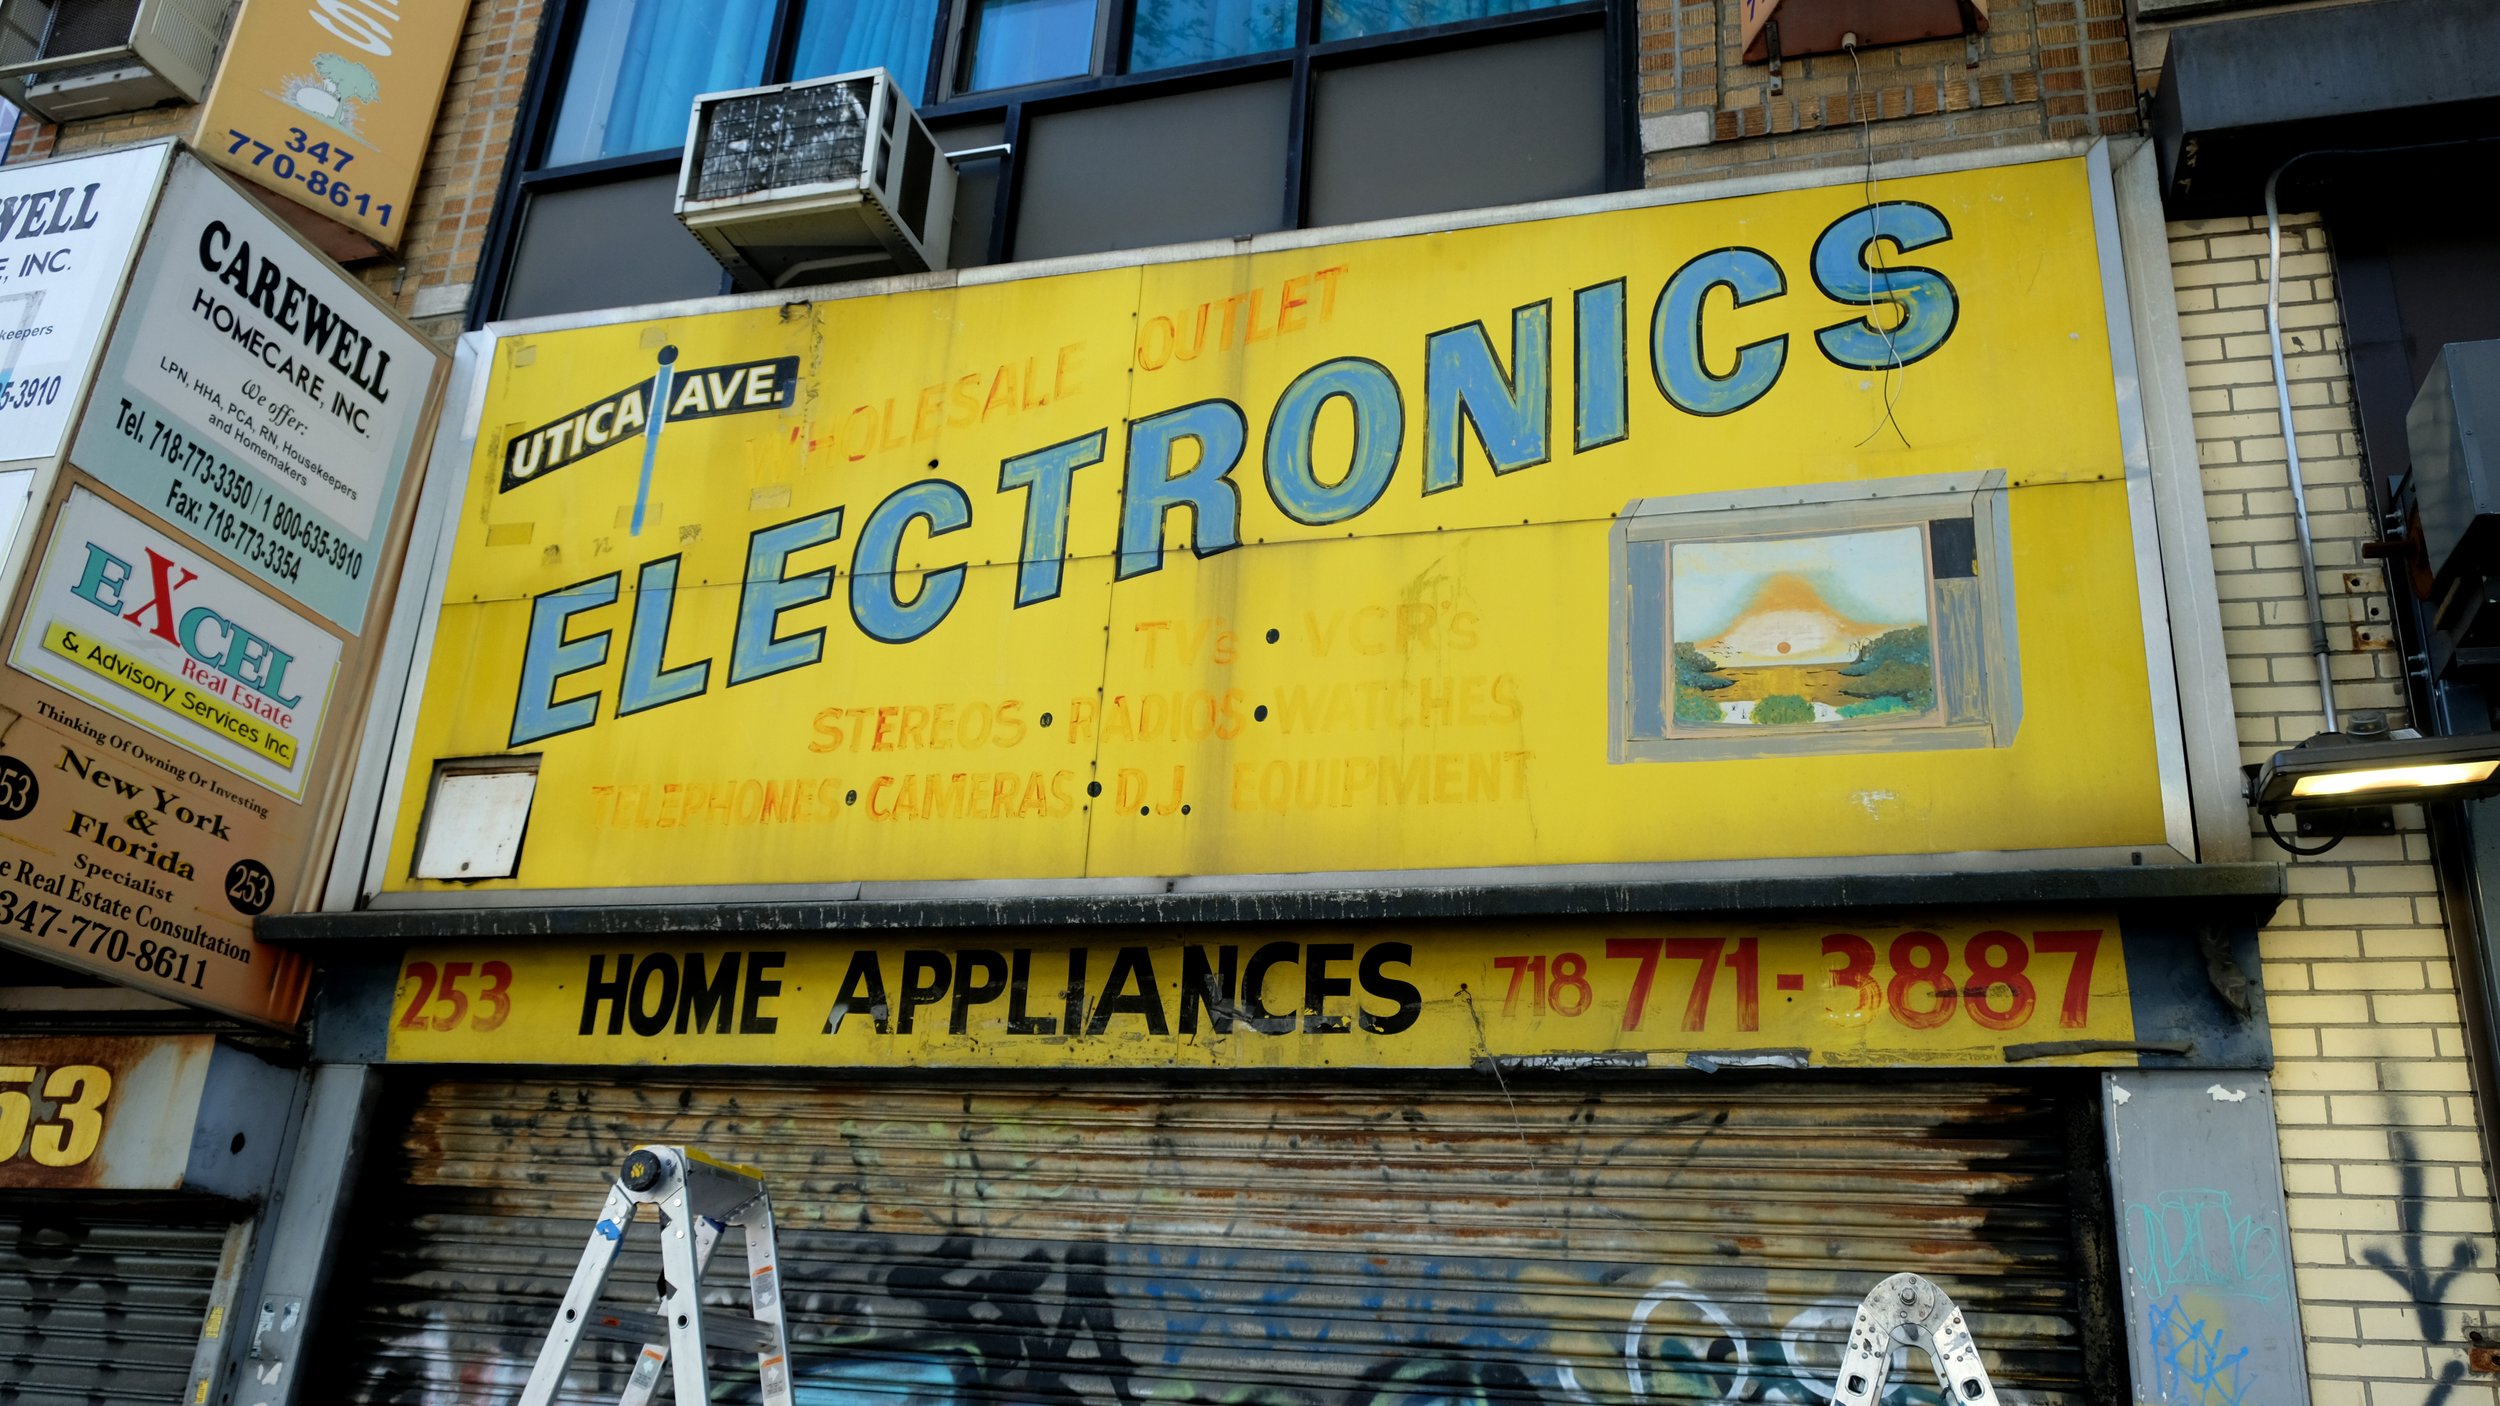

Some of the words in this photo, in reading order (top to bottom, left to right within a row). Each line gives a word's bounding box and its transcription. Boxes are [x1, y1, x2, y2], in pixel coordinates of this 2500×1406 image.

[227, 129, 392, 227] 770-8611
[284, 127, 354, 173] 347
[18, 249, 71, 278] INC.
[0, 325, 54, 341] keepers
[199, 220, 390, 404] CAREWELL
[0, 375, 62, 411] 5-3910
[192, 288, 325, 408] HOMECARE,
[331, 391, 370, 439] INC.
[241, 379, 266, 407] We
[269, 403, 308, 435] offer:
[749, 341, 1086, 483] WHOLESALE
[1137, 264, 1349, 371] OUTLET
[160, 356, 190, 387] LPN,
[193, 379, 224, 411] HHA,
[228, 403, 255, 433] PCA,
[259, 425, 279, 449] RN,
[282, 441, 357, 501] Housekeepers
[209, 413, 232, 435] and
[234, 428, 307, 486] Homemakers
[512, 389, 645, 478] UTICA
[671, 364, 784, 416] AVE.
[116, 398, 145, 443] Tel.
[149, 420, 253, 509] 718-773-3350
[262, 495, 273, 522] 1
[273, 502, 362, 580] 800-635-3910
[509, 200, 1960, 748] ELECTRONICS
[166, 479, 202, 524] Fax:
[204, 502, 301, 584] 718-773-3354
[70, 541, 302, 710] EXCEL
[1304, 600, 1480, 658] VCR's
[61, 631, 79, 653] &
[87, 646, 175, 702] Advisory
[181, 691, 258, 743] Services
[265, 733, 290, 760] Inc.
[181, 658, 227, 696] Real
[231, 684, 292, 729] Estate
[808, 699, 1027, 753] STEREOS
[1067, 688, 1247, 744] RADIOS
[1274, 673, 1523, 734] WATCHES
[37, 700, 107, 746] Thinking
[110, 734, 132, 753] Of
[131, 745, 186, 781] Owning
[189, 771, 208, 788] Or
[210, 780, 269, 820] Investing
[54, 745, 143, 800] New
[151, 785, 232, 842] York
[592, 775, 843, 829] TELEPHONES
[865, 770, 1075, 823] CAMERAS
[1114, 765, 1191, 817] D.J.
[1232, 751, 1535, 814] EQUIPMENT
[63, 810, 195, 881] Florida
[124, 809, 159, 836] &
[14, 859, 66, 897] Real
[67, 878, 131, 920] Estate
[135, 904, 251, 963] Consultation
[74, 853, 175, 903] Specialist
[229, 863, 270, 908] 253
[0, 890, 208, 990] 347-770-8611
[1494, 952, 1593, 1018] 718
[1605, 929, 2104, 1032] 771-3887
[398, 960, 513, 1032] 253
[579, 951, 786, 1037] HOME
[821, 942, 1422, 1038] APPLIANCES
